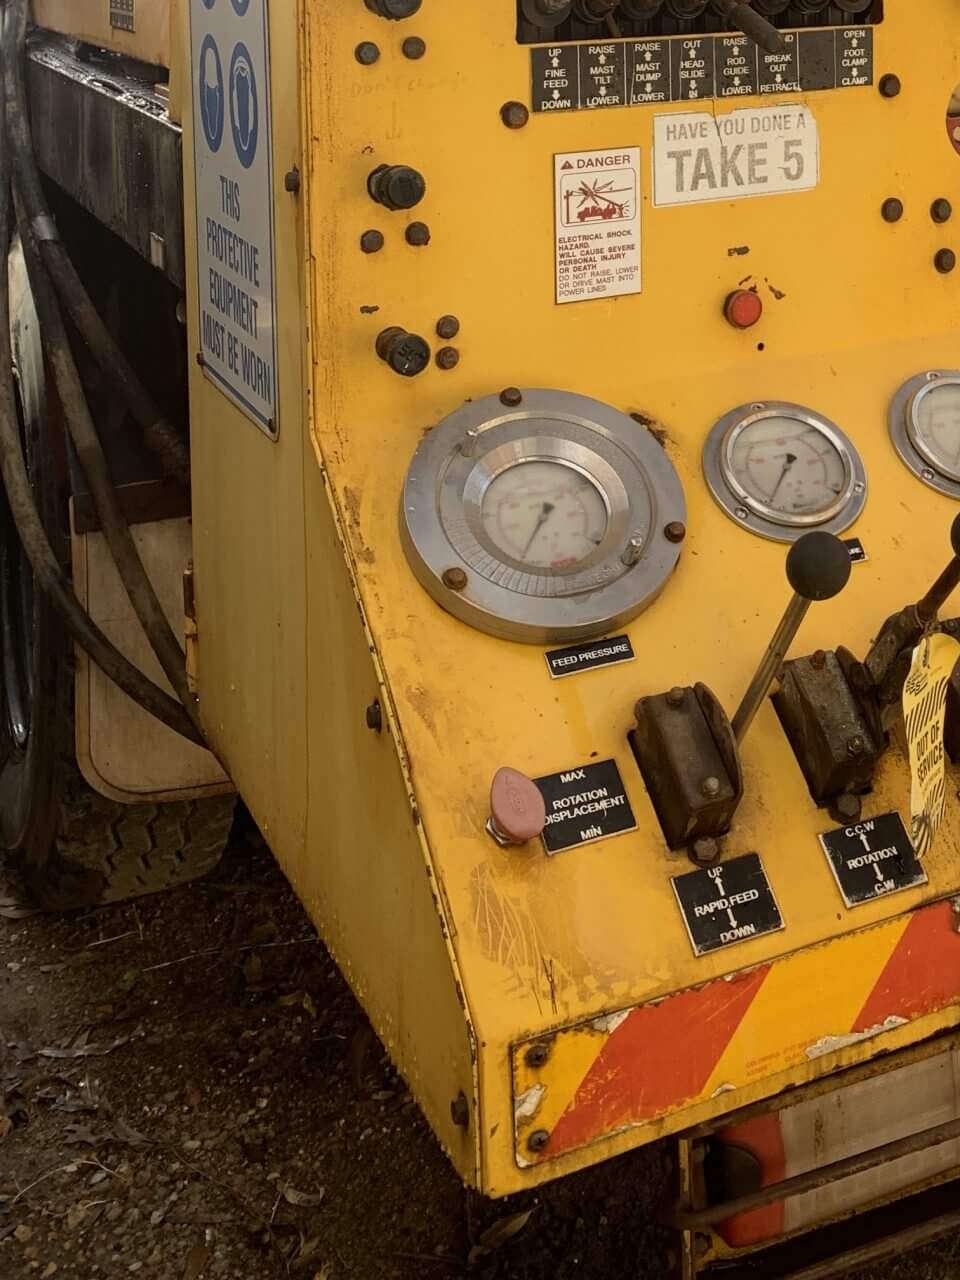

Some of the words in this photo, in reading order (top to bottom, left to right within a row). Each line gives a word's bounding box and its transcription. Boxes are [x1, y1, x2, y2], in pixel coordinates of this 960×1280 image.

[844, 30, 866, 38] OPEN
[683, 40, 702, 48] OUT
[723, 37, 748, 46] RAISE
[588, 45, 616, 54] RAISE
[634, 42, 661, 52] RAISE
[548, 48, 562, 57] UP
[844, 48, 865, 57] FOOT
[727, 57, 746, 66] ROD
[764, 54, 792, 63] BREAK
[842, 58, 868, 66] CLAMP
[636, 62, 660, 72] MAST
[680, 60, 704, 68] HEAD
[770, 64, 787, 72] OUT
[545, 69, 566, 78] FINE
[590, 65, 615, 75] MAST
[680, 70, 704, 79] SLIDE
[723, 67, 750, 76] GUIDE
[594, 76, 611, 85] TILT
[636, 73, 662, 82] DUMP
[842, 76, 868, 86] CLAMP
[544, 80, 568, 88] FEED
[760, 82, 797, 93] RETRACT
[688, 90, 698, 98] IN
[722, 86, 752, 96] LOWER
[586, 96, 619, 106] LOWER
[633, 92, 664, 102] LOWER
[542, 100, 570, 110] DOWN
[666, 121, 708, 141] HAVE
[715, 117, 746, 136] YOU
[752, 114, 792, 133] DONE
[796, 112, 806, 129] A
[577, 154, 631, 169] DANGER
[667, 142, 768, 192] TAKE
[782, 139, 804, 180] 5
[220, 175, 240, 221] THIS
[558, 233, 603, 244] ELECTRICAL
[606, 230, 632, 238] SHOCK
[206, 217, 260, 288] PROTECTIVE
[580, 248, 604, 256] CAUSE
[608, 244, 635, 252] SEVERE
[558, 256, 597, 266] PERSONAL
[600, 253, 626, 261] INJURY
[572, 264, 596, 272] DEATH
[616, 266, 638, 274] LOWER
[559, 282, 570, 290] OR
[572, 280, 592, 288] DRIVE
[596, 276, 614, 284] MAST
[559, 288, 584, 296] POWER
[588, 285, 606, 294] LINES
[210, 268, 258, 340] EQUIPMENT
[202, 310, 225, 357] MUST
[228, 332, 238, 376] BE
[240, 343, 272, 404] WORN
[552, 654, 578, 668] FEED
[579, 643, 629, 661] PRESSURE
[916, 731, 929, 761] OUT
[930, 720, 940, 745] OF
[916, 743, 944, 782] SERVICE
[560, 769, 586, 784] MAX
[552, 788, 608, 810] ROTATION
[544, 795, 624, 826] DISPLACEMENT
[580, 826, 602, 840] MIN
[845, 820, 874, 838] C.C.W
[847, 846, 898, 870] ROTATION
[707, 866, 723, 878] UP
[874, 879, 896, 894] C.W
[694, 898, 728, 918] RAPID
[729, 889, 759, 906] FEED
[720, 924, 756, 944] DOWN
